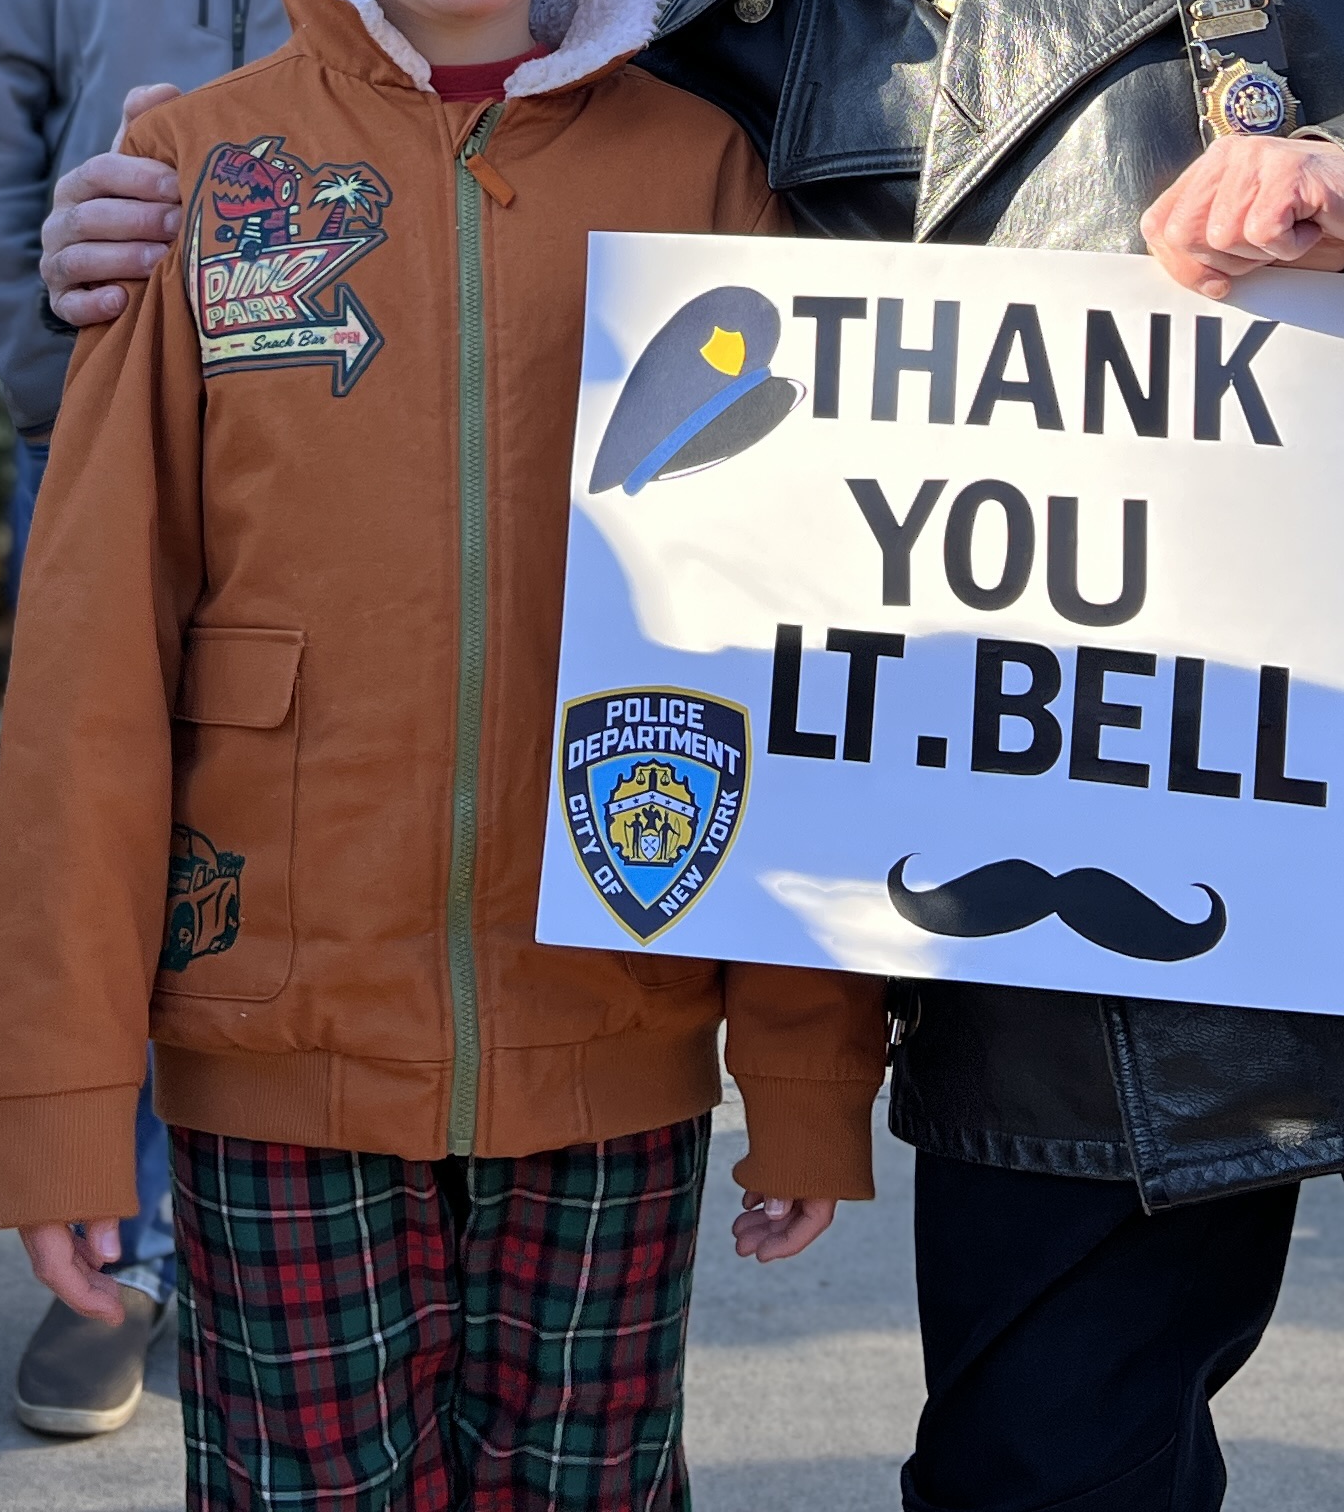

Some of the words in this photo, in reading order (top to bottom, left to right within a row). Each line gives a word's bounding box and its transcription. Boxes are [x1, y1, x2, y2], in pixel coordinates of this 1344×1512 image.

[206, 248, 329, 305] DINO
[206, 294, 297, 331] PARK
[333, 331, 361, 345] OPEN
[252, 331, 295, 352] Snack
[298, 330, 327, 347] Bar
[793, 296, 1283, 446] THANK
[844, 478, 1147, 627] YOU
[606, 697, 705, 730] POLICE
[567, 725, 741, 776] DEPARTMENT
[568, 793, 602, 856] CITY
[593, 865, 623, 896] OF
[658, 864, 704, 917] NEW
[701, 789, 740, 855] YORK
